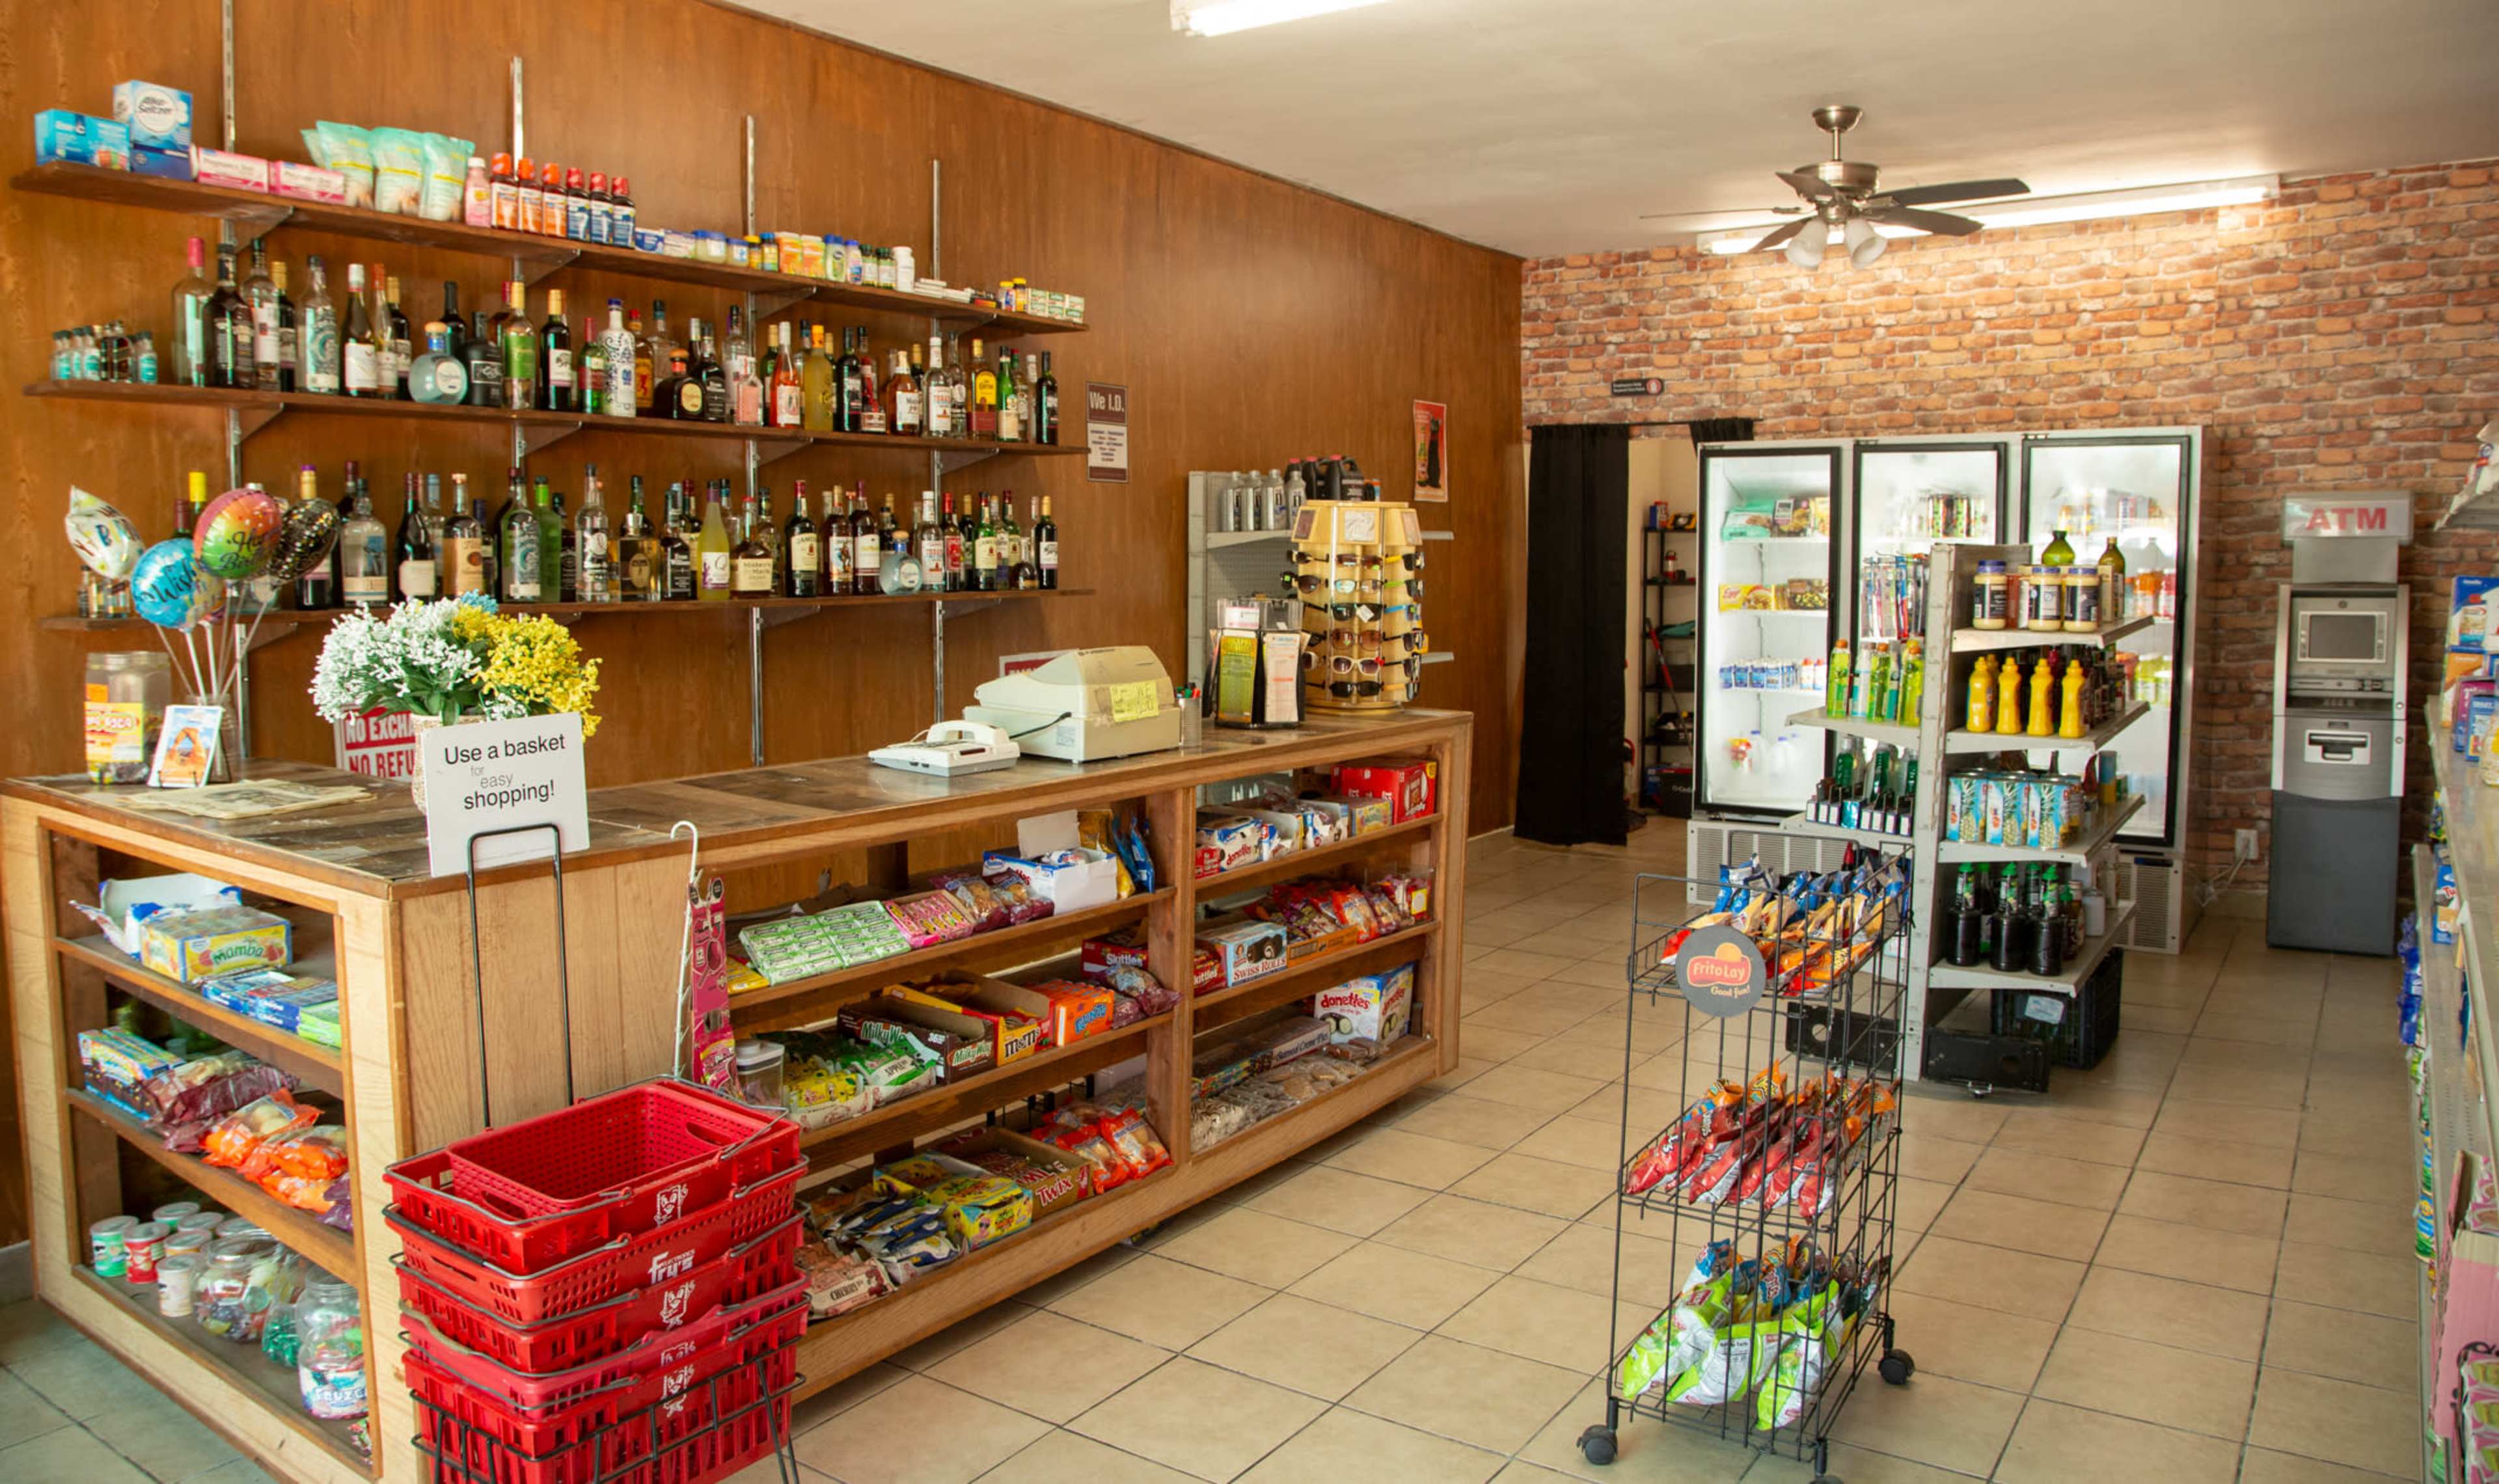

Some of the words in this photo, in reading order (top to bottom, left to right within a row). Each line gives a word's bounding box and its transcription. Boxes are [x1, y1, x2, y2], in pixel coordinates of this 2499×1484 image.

[1089, 392, 1105, 410] We
[1108, 394, 1125, 412] I.D.
[2306, 507, 2387, 530] ATM
[345, 717, 366, 744] NO
[369, 712, 416, 741] EXCHA
[445, 746, 482, 766] Use
[487, 745, 499, 759] a
[505, 734, 566, 757] basket
[349, 755, 371, 776] NO
[376, 749, 415, 777] REFU
[471, 765, 485, 777] for
[480, 772, 513, 789] easy
[464, 780, 555, 811] shopping!
[1106, 953, 1143, 967] Skittles
[1320, 992, 1371, 1010] donettes
[1710, 986, 1733, 997] Good
[1733, 985, 1750, 999] fun!
[1035, 1177, 1074, 1207] Twix
[648, 1252, 694, 1285] Fry's
